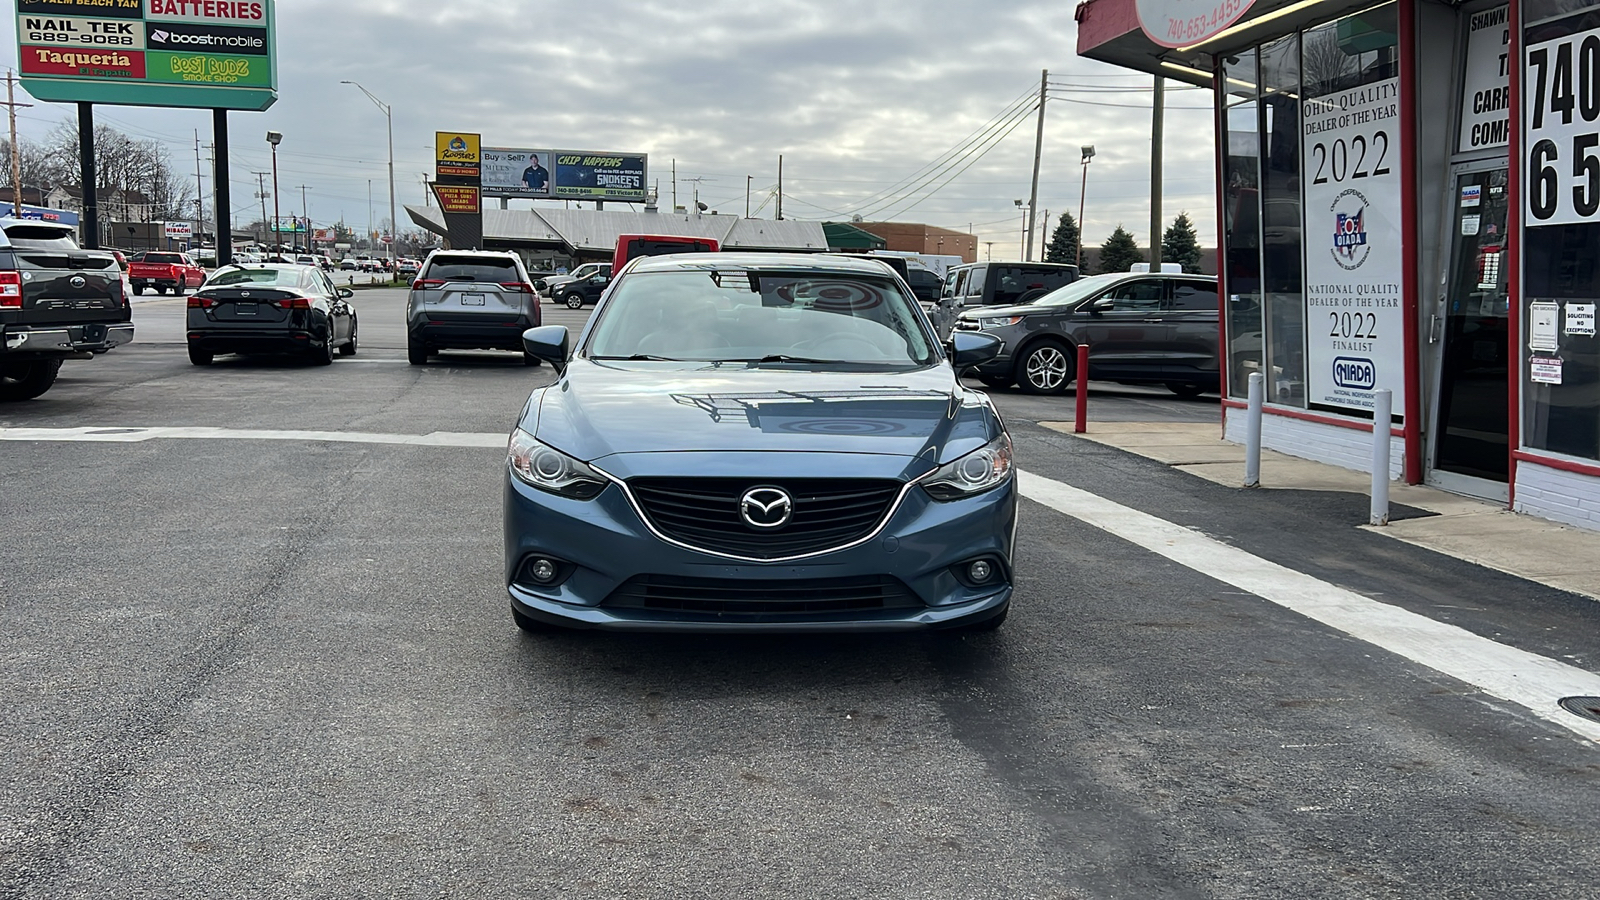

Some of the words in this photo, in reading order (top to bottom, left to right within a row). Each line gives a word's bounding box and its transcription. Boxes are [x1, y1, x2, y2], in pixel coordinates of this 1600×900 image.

[117, 0, 138, 8] TAN
[151, 0, 262, 20] BATTERIES
[26, 18, 78, 32] NAIL
[87, 22, 134, 34] TEK
[1168, 0, 1240, 39] 740-653-4455
[1471, 8, 1505, 31] SHAWN
[30, 32, 134, 45] 689-9088
[170, 32, 262, 47] boostmobile
[36, 50, 130, 67] Taqueria
[208, 58, 249, 76] BUDZ
[183, 74, 212, 82] SMOKE
[1529, 35, 1600, 130] 740
[1304, 98, 1334, 118] OHIO
[1340, 82, 1398, 111] QUALITY
[1306, 117, 1337, 135] DEALER
[1339, 114, 1350, 128] OF
[1352, 110, 1370, 125] THE
[1372, 104, 1397, 120] YEAR
[558, 156, 581, 165] CHIP
[583, 156, 623, 167] HAPPENS
[1313, 130, 1390, 184] 2022
[1530, 132, 1600, 220] 65
[1338, 233, 1361, 245] OIADA
[1309, 284, 1353, 294] NATIONAL
[1357, 284, 1399, 295] QUALITY
[1310, 298, 1339, 306] DEALER
[1342, 298, 1352, 306] OF
[1356, 298, 1372, 307] THE
[1376, 298, 1398, 307] YEAR
[1330, 312, 1377, 339] 2022
[1333, 341, 1373, 352] FINALIST
[1336, 363, 1371, 384] NIADA
